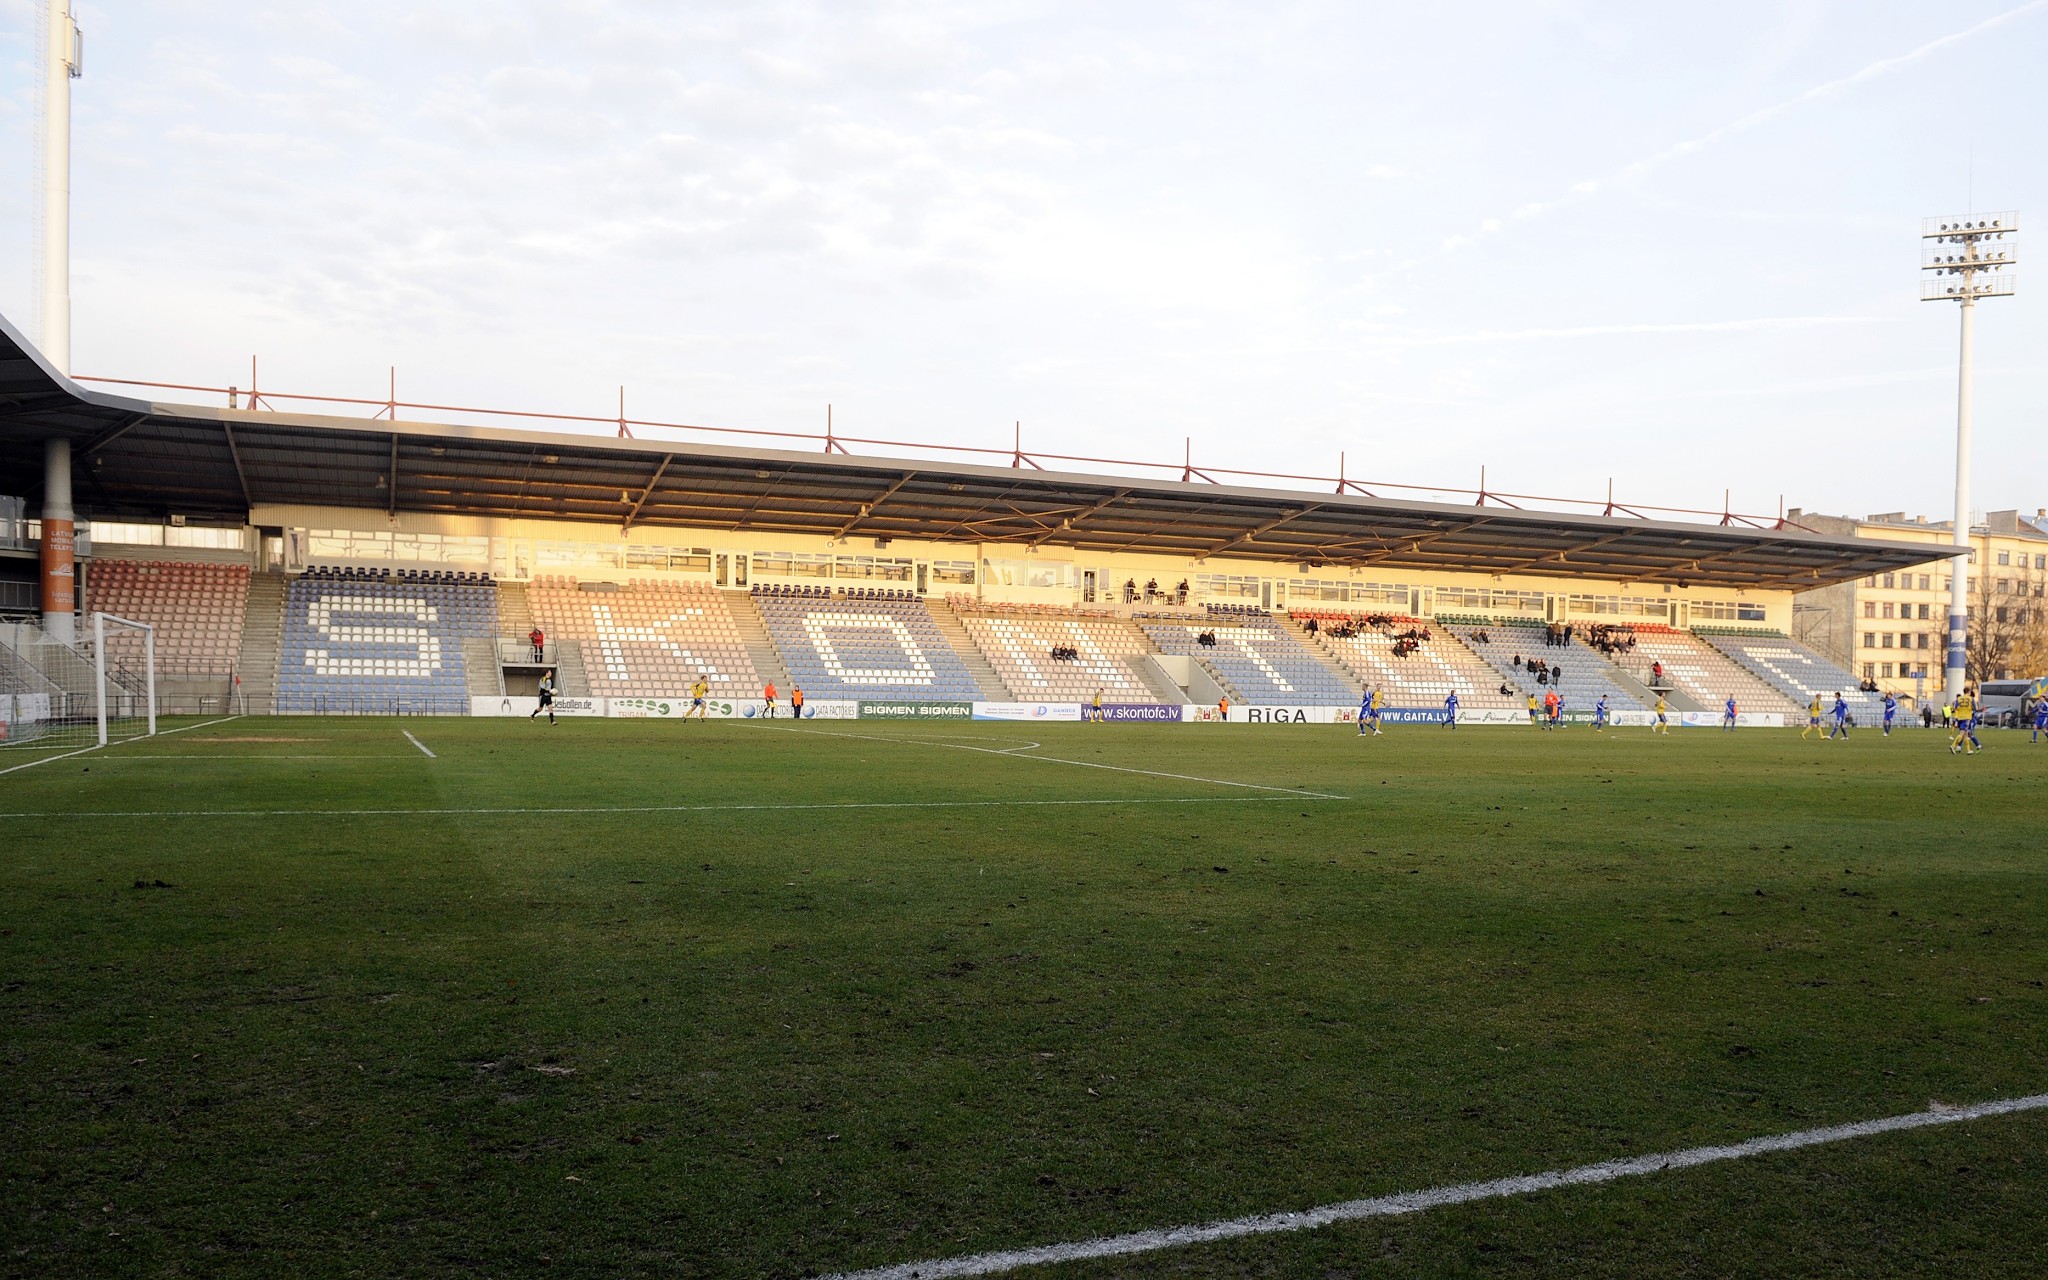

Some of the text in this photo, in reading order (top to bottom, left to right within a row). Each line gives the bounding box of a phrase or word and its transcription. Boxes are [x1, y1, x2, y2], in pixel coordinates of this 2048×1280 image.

[773, 705, 794, 715] ACTORIE
[816, 706, 829, 715] DATA
[864, 706, 970, 715] SIGMEN SIGMEN
[1575, 714, 1609, 722] SIGMN
